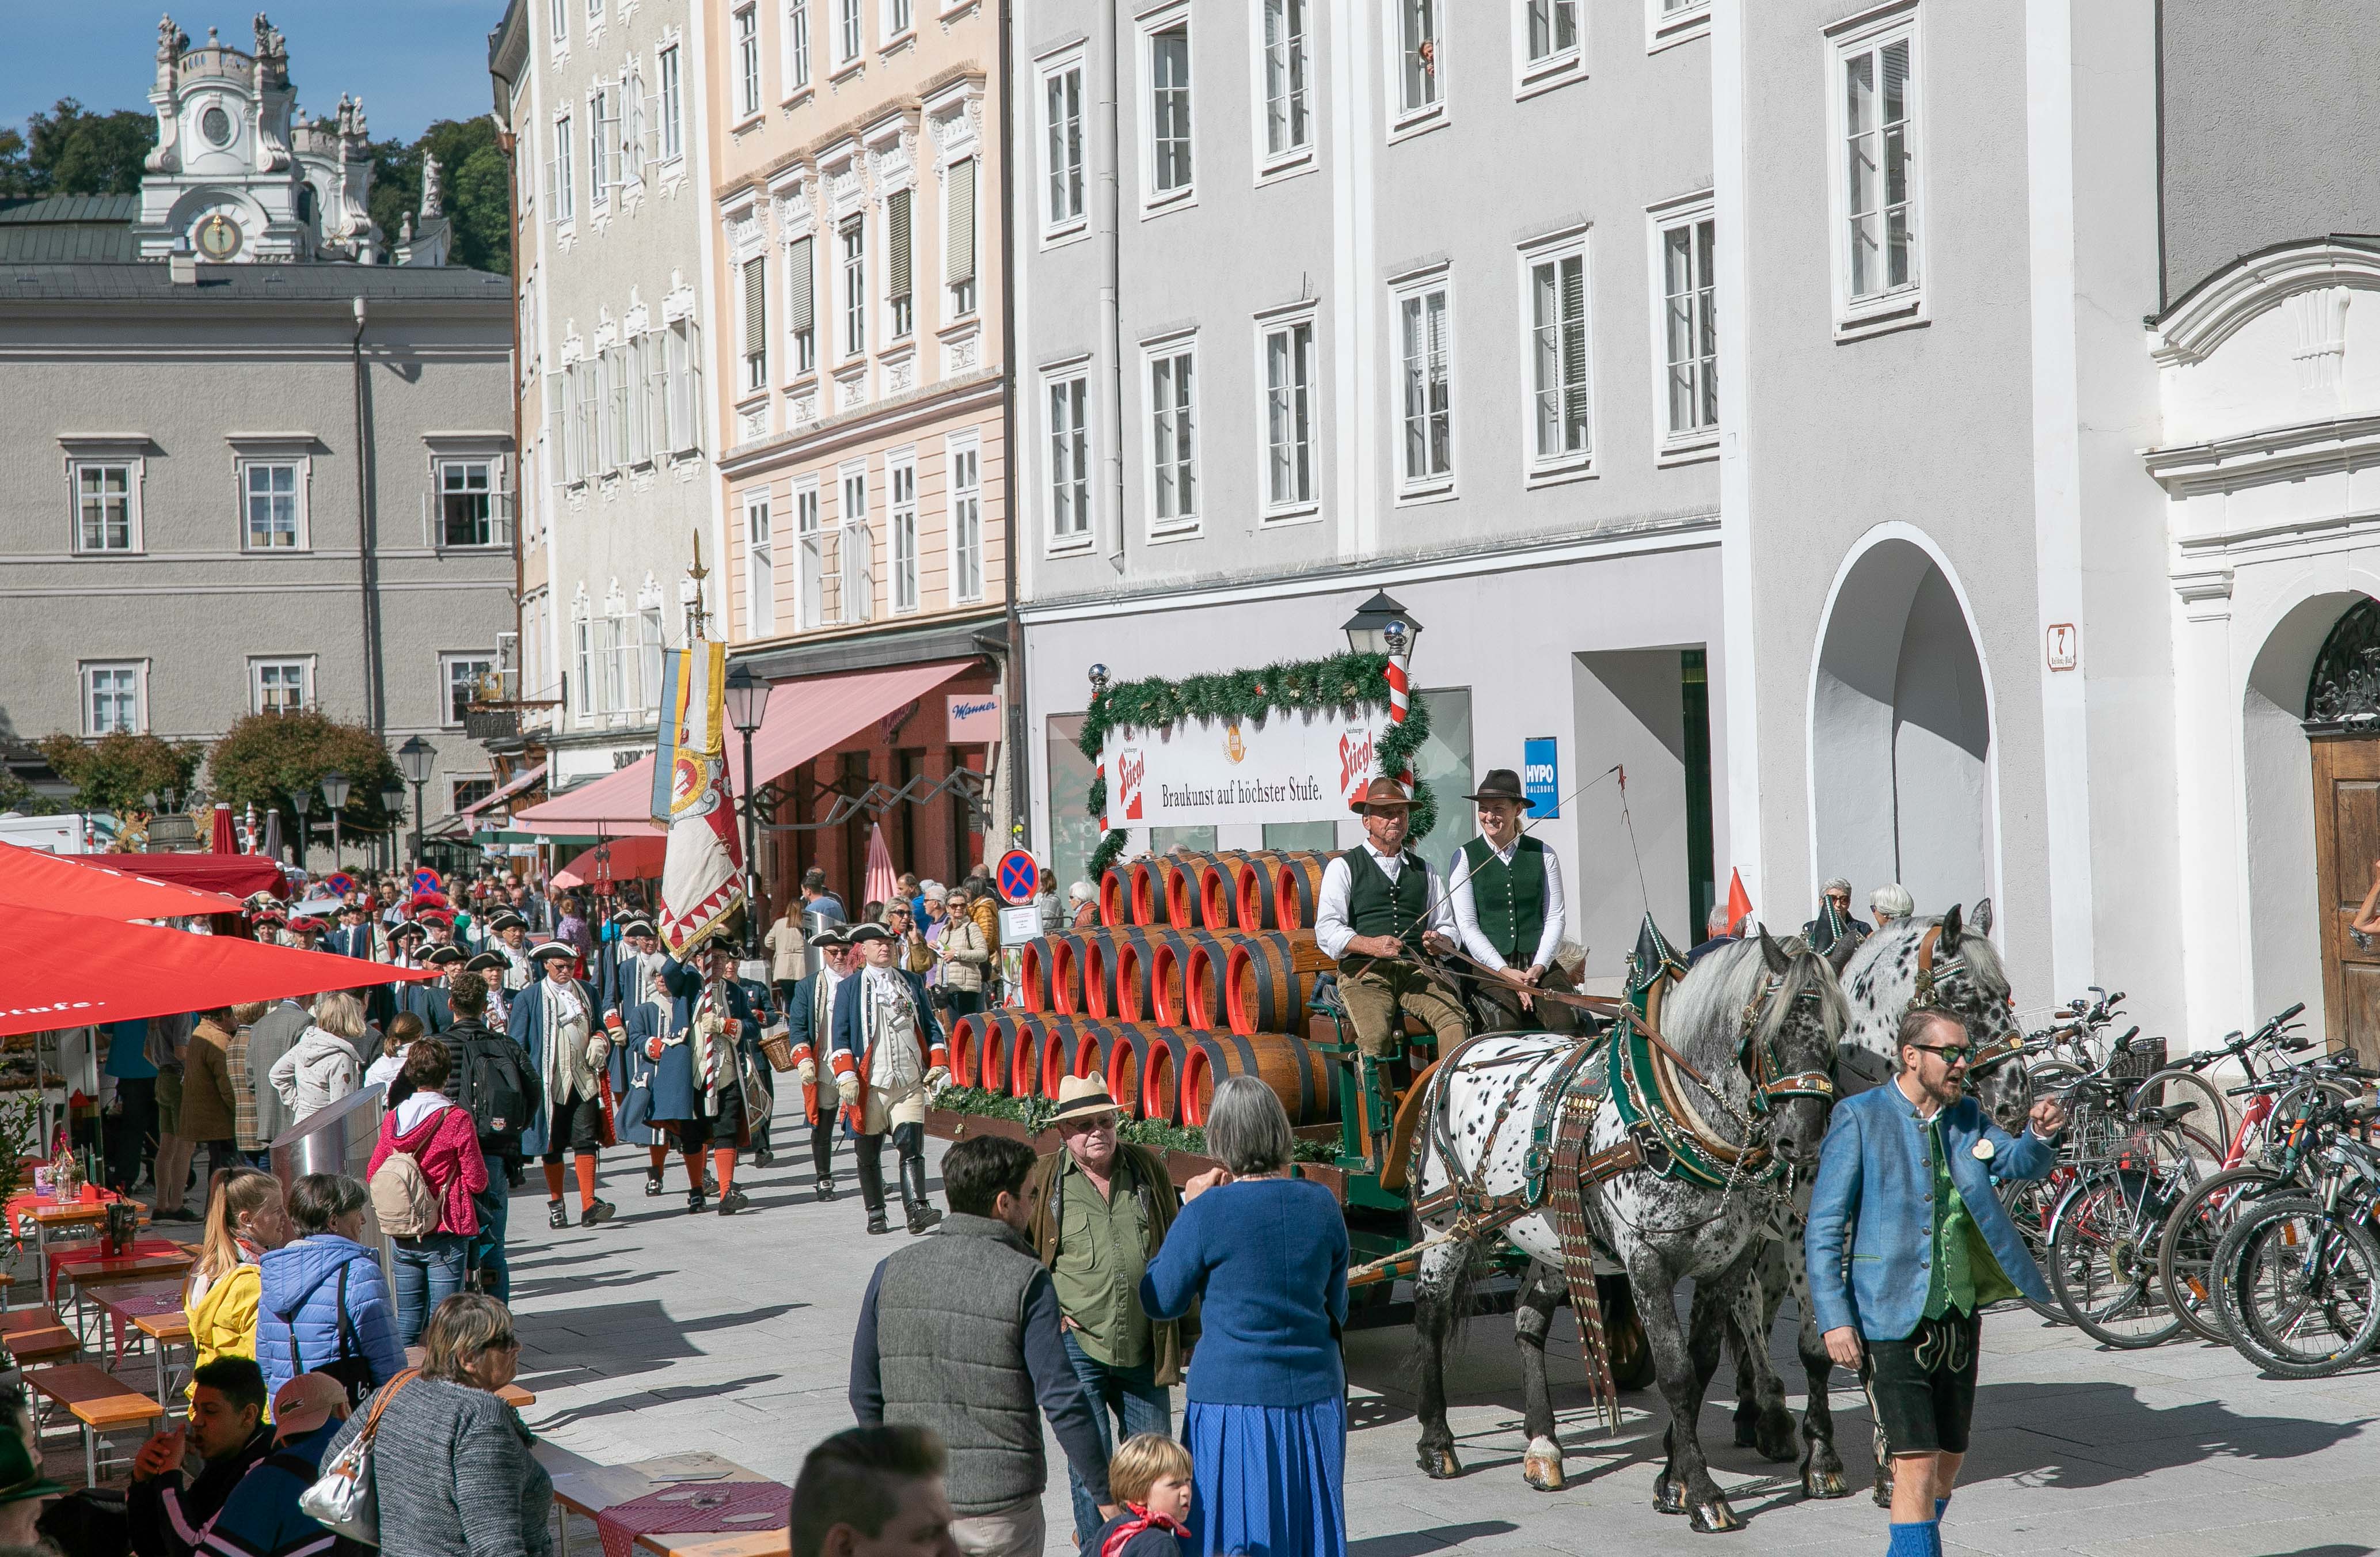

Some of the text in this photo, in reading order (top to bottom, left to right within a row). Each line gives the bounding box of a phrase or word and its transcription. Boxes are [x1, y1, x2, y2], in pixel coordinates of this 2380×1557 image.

[2058, 628, 2066, 655] 7
[952, 701, 997, 720] Manner
[1346, 727, 1364, 735] Salzburger
[1339, 729, 1373, 796] Stiegl
[1119, 749, 1145, 807] Stiegl
[1526, 764, 1554, 783] HYPO
[1162, 775, 1322, 807] Braukunst auf höchster Stufe.
[1527, 784, 1554, 793] SALZBURG
[1009, 895, 1030, 905] ANFANG
